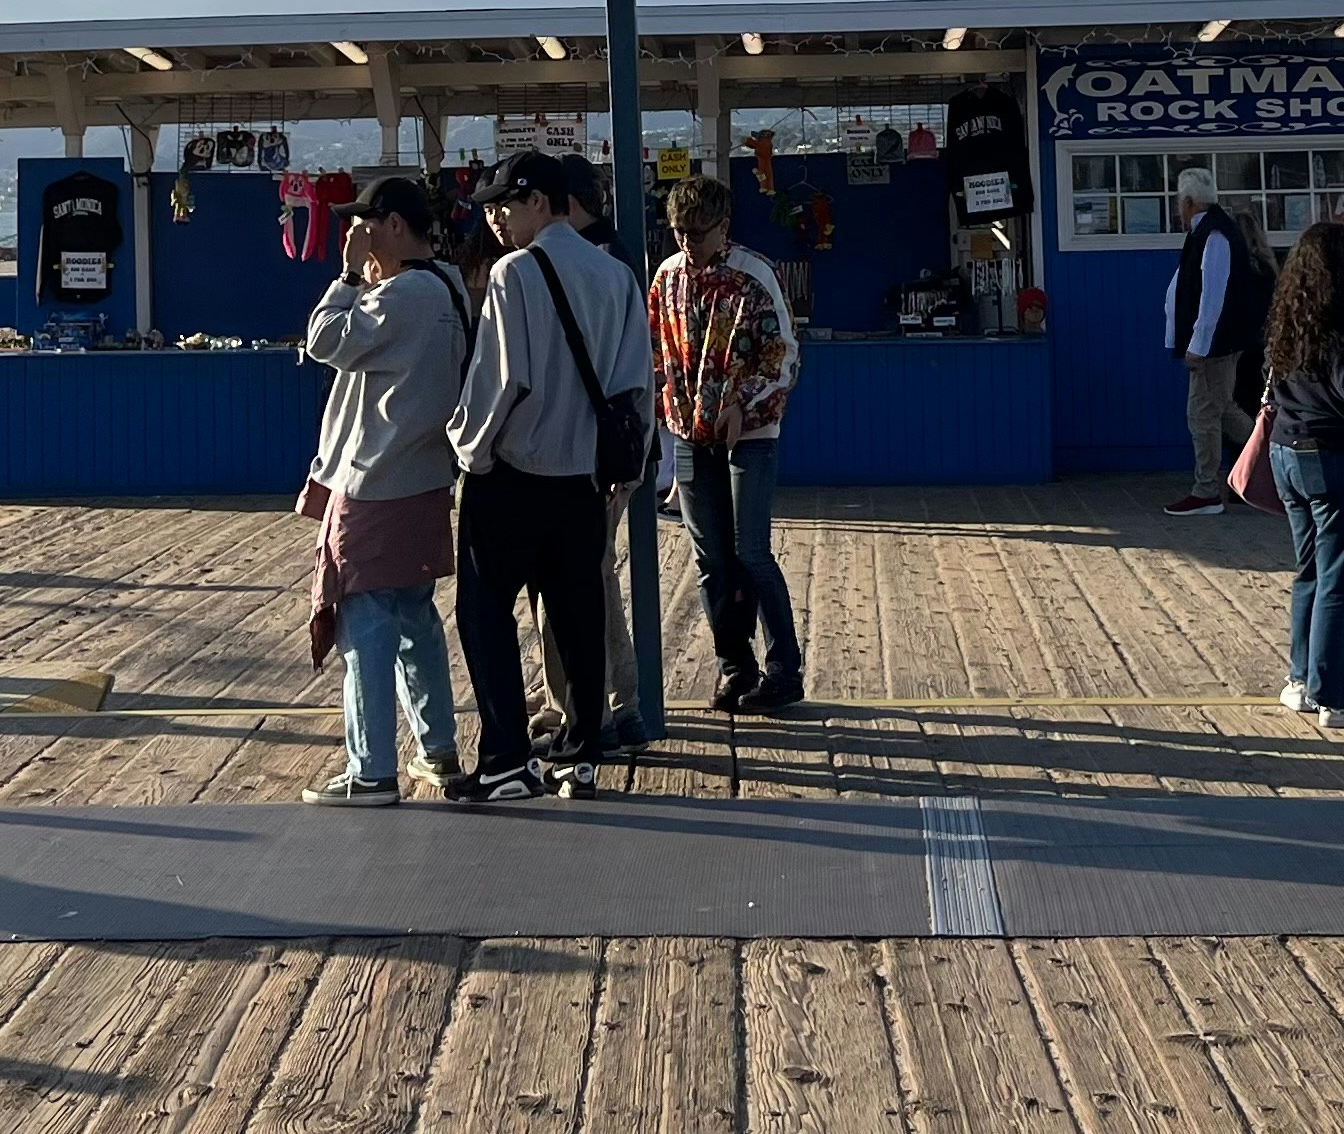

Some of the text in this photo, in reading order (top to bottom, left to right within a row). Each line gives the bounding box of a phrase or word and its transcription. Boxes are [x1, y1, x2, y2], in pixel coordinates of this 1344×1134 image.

[1096, 99, 1239, 121] ROCK
[546, 127, 574, 136] CASH
[546, 137, 574, 147] ONLY
[661, 153, 686, 162] CASH
[661, 164, 686, 173] ONLY
[851, 167, 884, 178] ONLY
[65, 257, 102, 265] HOODIES
